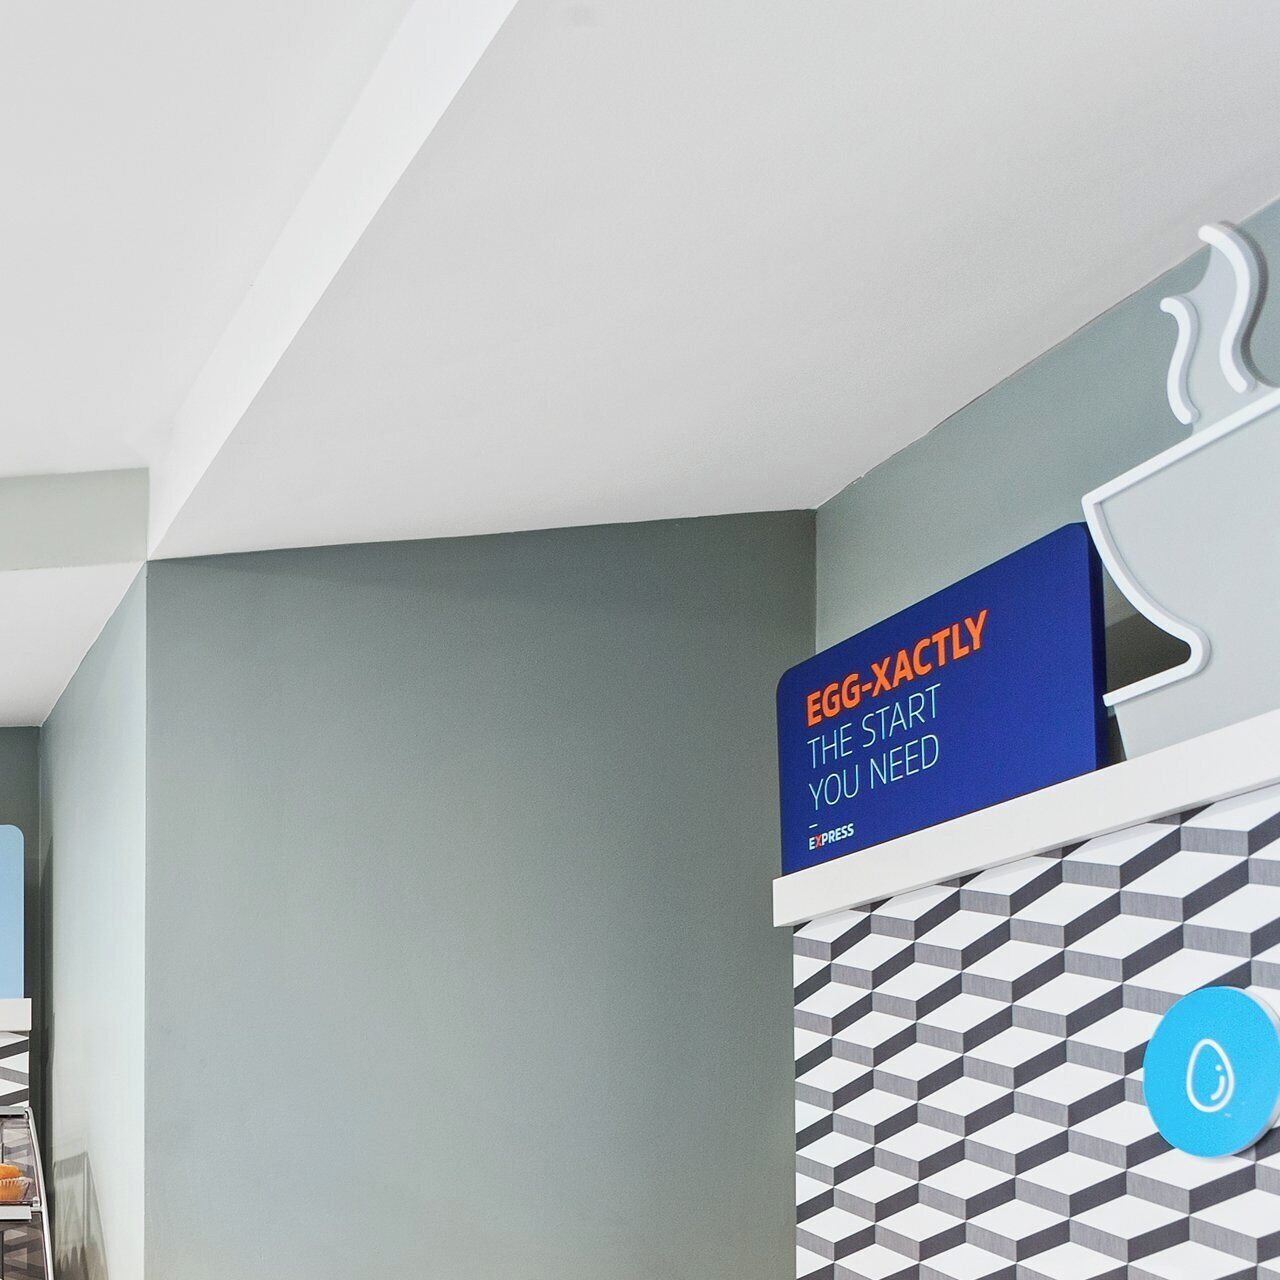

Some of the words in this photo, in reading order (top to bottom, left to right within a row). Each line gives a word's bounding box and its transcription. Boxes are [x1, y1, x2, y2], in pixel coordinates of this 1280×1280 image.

[806, 608, 989, 728] EGG-XACTLY
[806, 722, 853, 769] THE
[861, 682, 941, 749] START
[808, 764, 859, 811] YOU
[869, 733, 940, 790] NEED
[808, 822, 855, 851] EXPRESS
